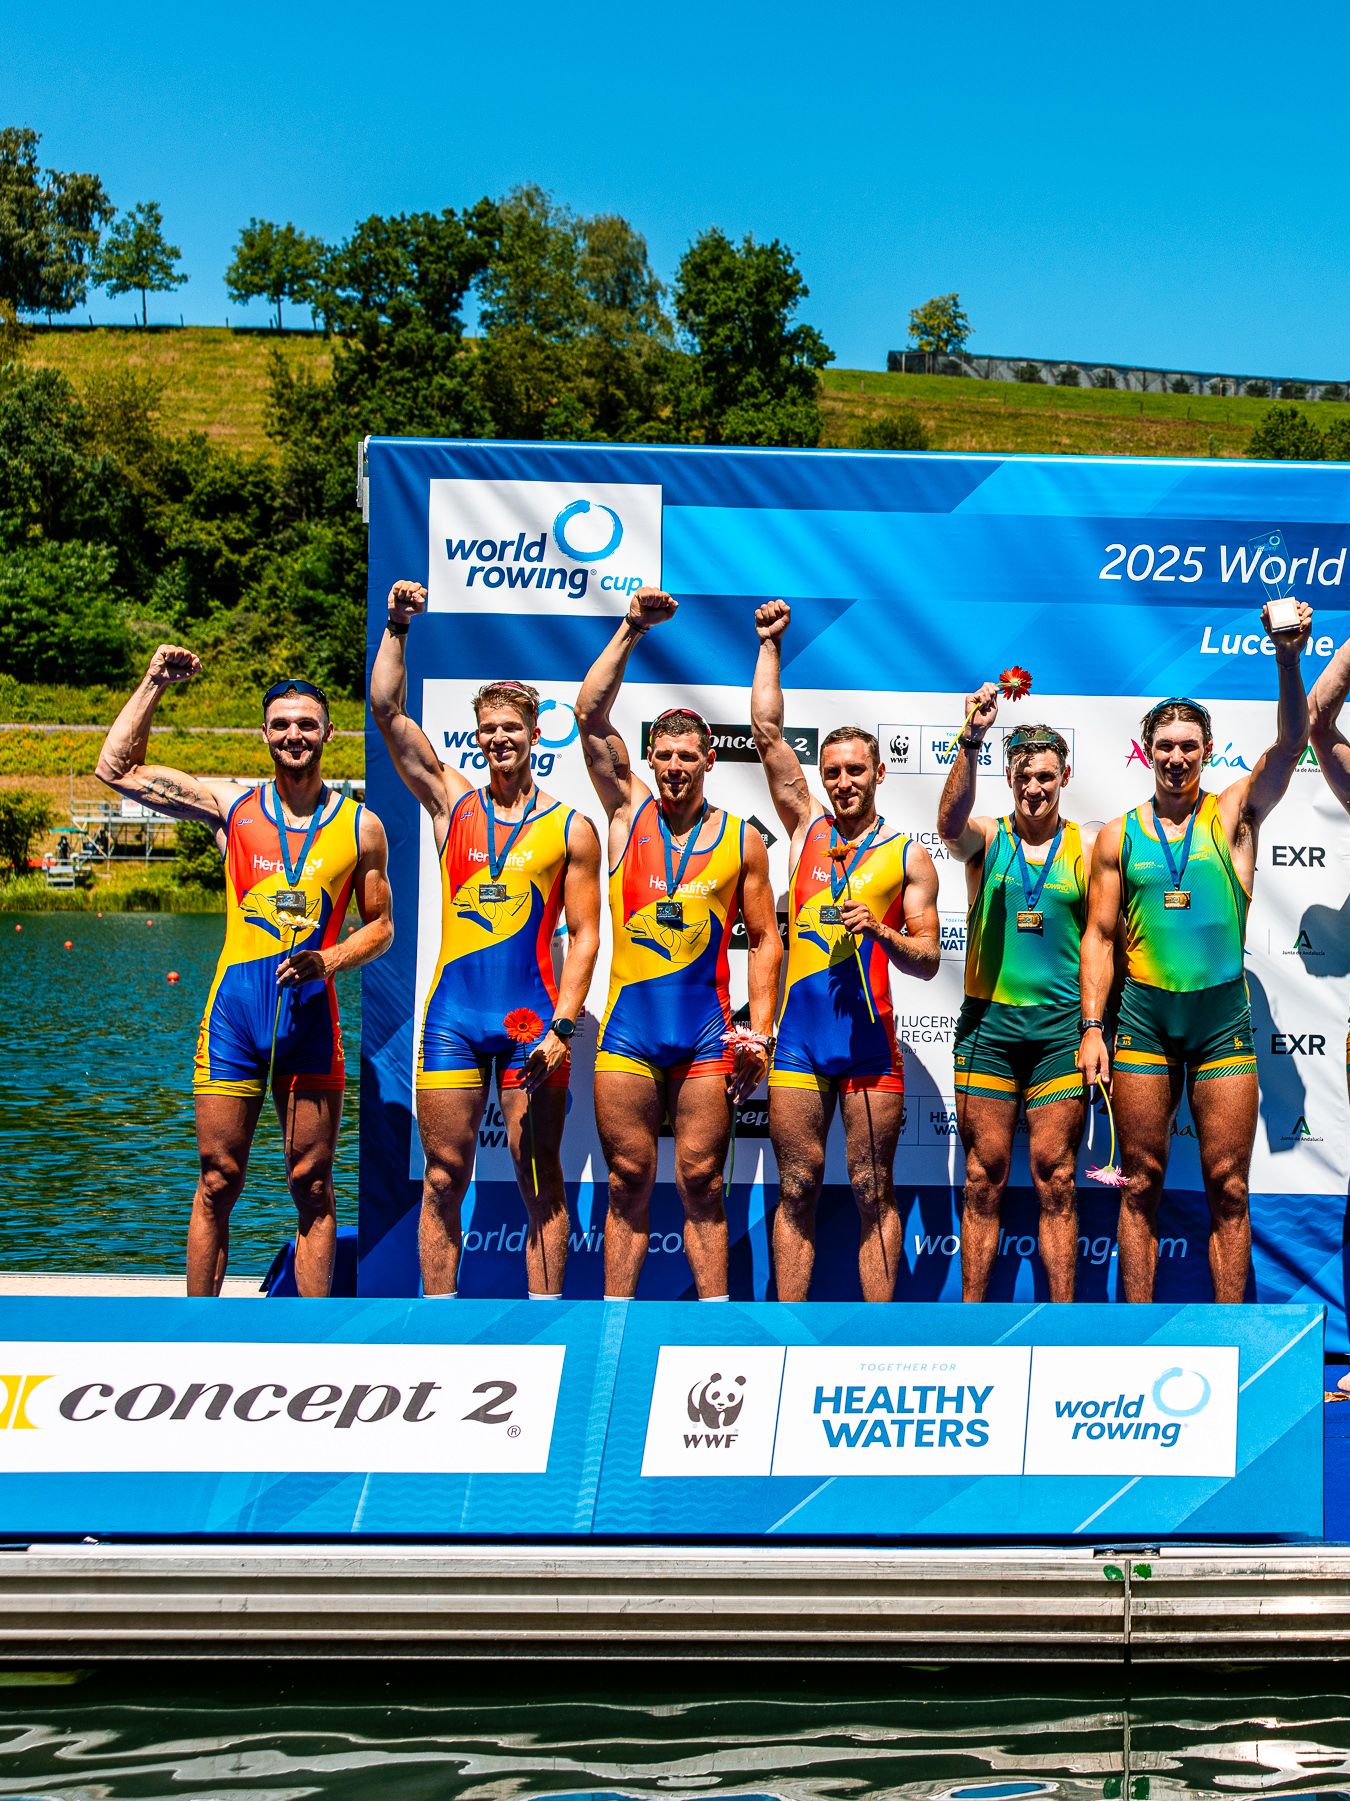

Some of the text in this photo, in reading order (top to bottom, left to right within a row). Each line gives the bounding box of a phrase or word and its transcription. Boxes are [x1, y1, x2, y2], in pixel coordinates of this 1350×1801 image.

[445, 531, 547, 563] world
[1100, 543, 1205, 583] 2025
[1220, 546, 1346, 587] World
[466, 568, 643, 598] rowing cup
[1201, 626, 1340, 657] Lucee
[708, 734, 807, 751] once 2
[931, 740, 992, 753] HEAY
[459, 751, 555, 777] rog
[935, 753, 992, 765] WARS
[253, 854, 315, 876] Herbfe
[468, 847, 526, 867] Herife
[1272, 845, 1326, 867] EXR
[649, 874, 709, 895] Healife
[811, 865, 864, 889] Herfe
[940, 939, 966, 951] WAT
[901, 1015, 959, 1028] LUCER
[901, 1030, 956, 1043] REGAT
[1270, 1033, 1326, 1055] EXR
[859, 1363, 957, 1371] TOGETHER FOR
[59, 1380, 519, 1429] concept 2
[813, 1385, 995, 1414] HEALTHY
[1055, 1395, 1143, 1420] world
[683, 1433, 739, 1449] WWF
[822, 1418, 990, 1448] WATERS
[1071, 1422, 1181, 1447] rowing
